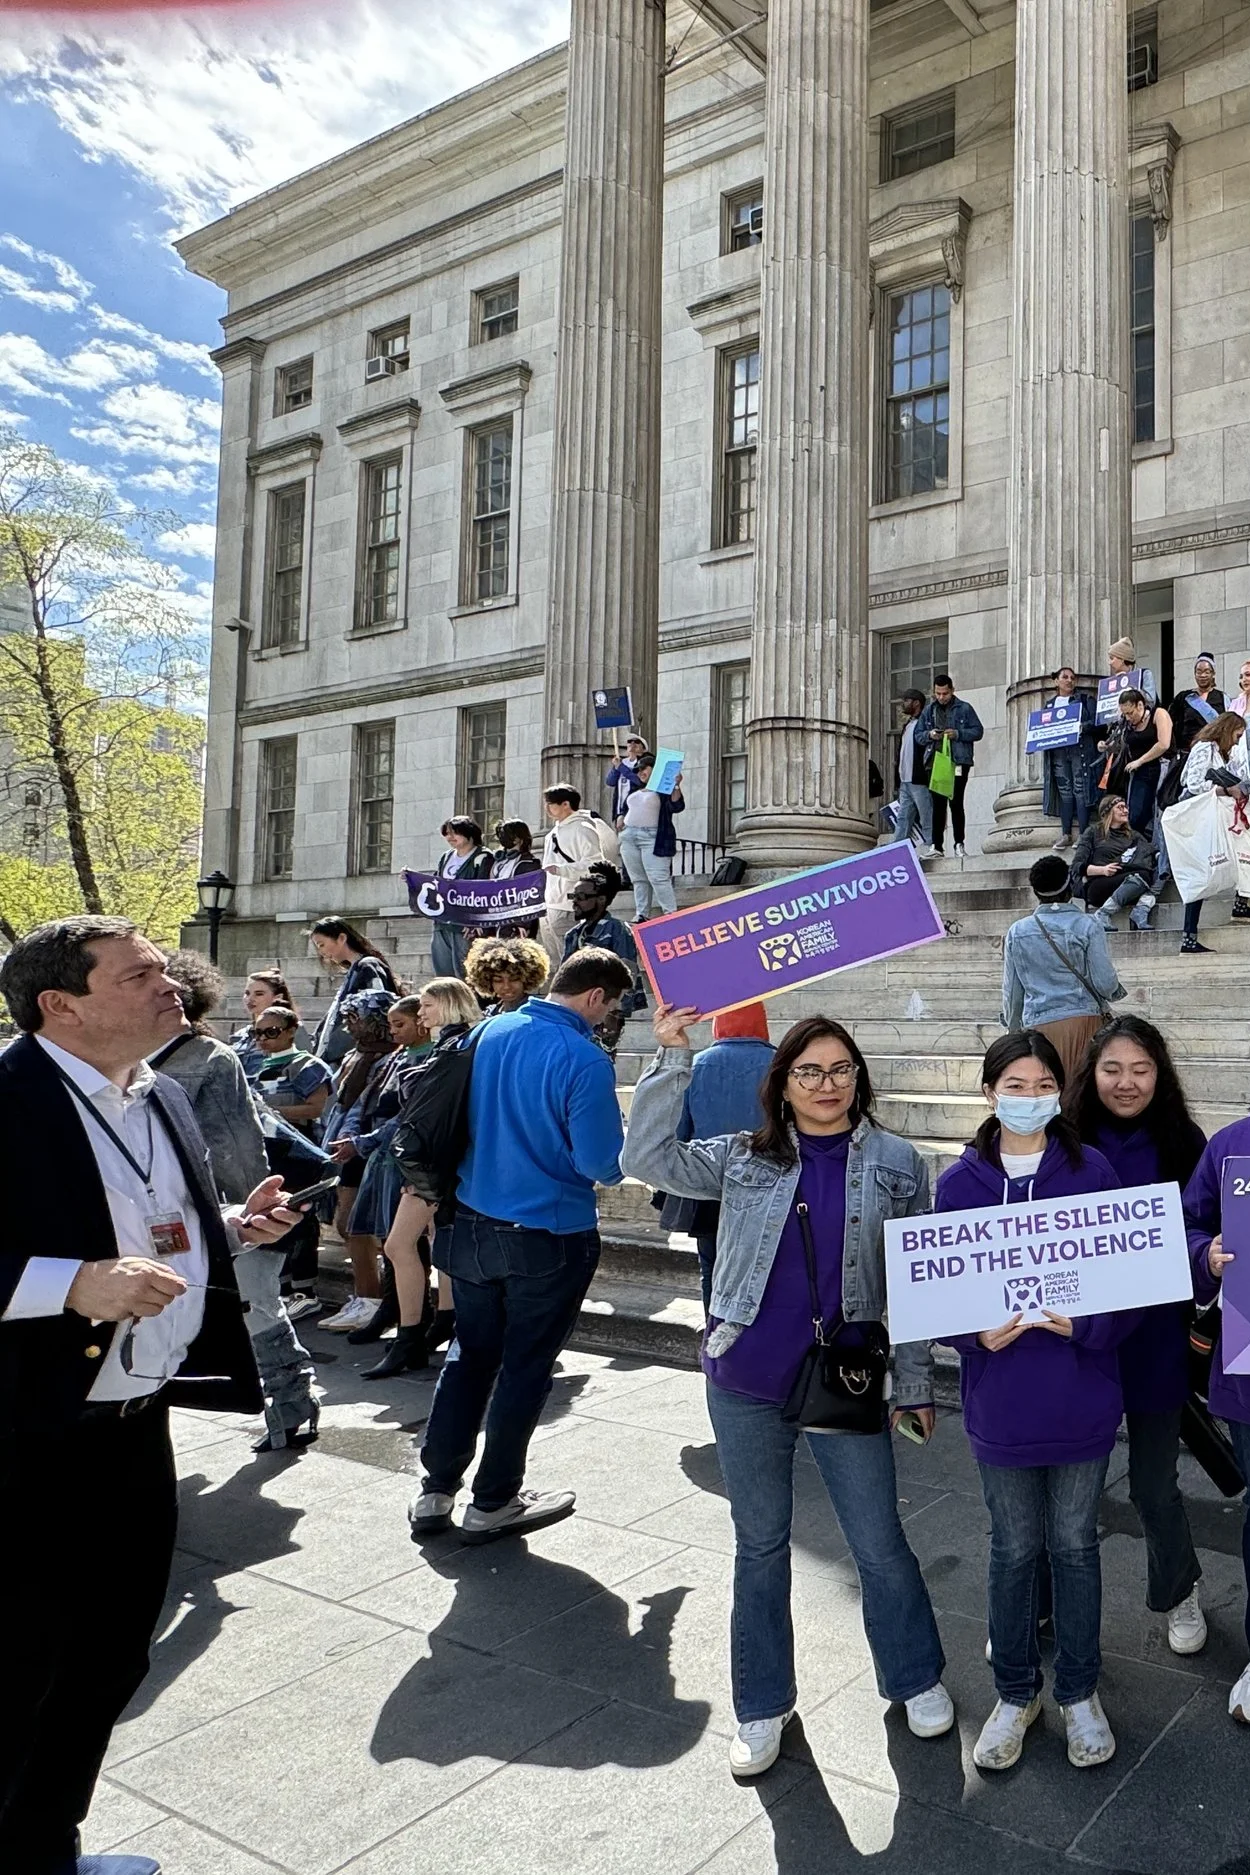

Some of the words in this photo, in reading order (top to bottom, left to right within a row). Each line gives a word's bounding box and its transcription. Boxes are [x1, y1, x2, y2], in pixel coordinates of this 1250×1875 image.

[447, 889, 489, 908] Garden
[490, 889, 503, 907] of
[504, 887, 540, 907] Hope
[654, 912, 765, 962] BELIEVE
[763, 865, 910, 926] SURVIVORS
[796, 919, 832, 937] KOREAN
[800, 931, 835, 950] FAMILY
[901, 1220, 993, 1252] BREAK
[997, 1213, 1049, 1239] THE
[1054, 1197, 1166, 1231] SILENCE
[910, 1256, 965, 1283] END
[970, 1246, 1024, 1274] THE
[1027, 1227, 1164, 1265] VIOLENCE
[1043, 1269, 1079, 1281] KOREAN
[1044, 1277, 1079, 1287] AMERICAN
[1045, 1283, 1080, 1296] FAMILY
